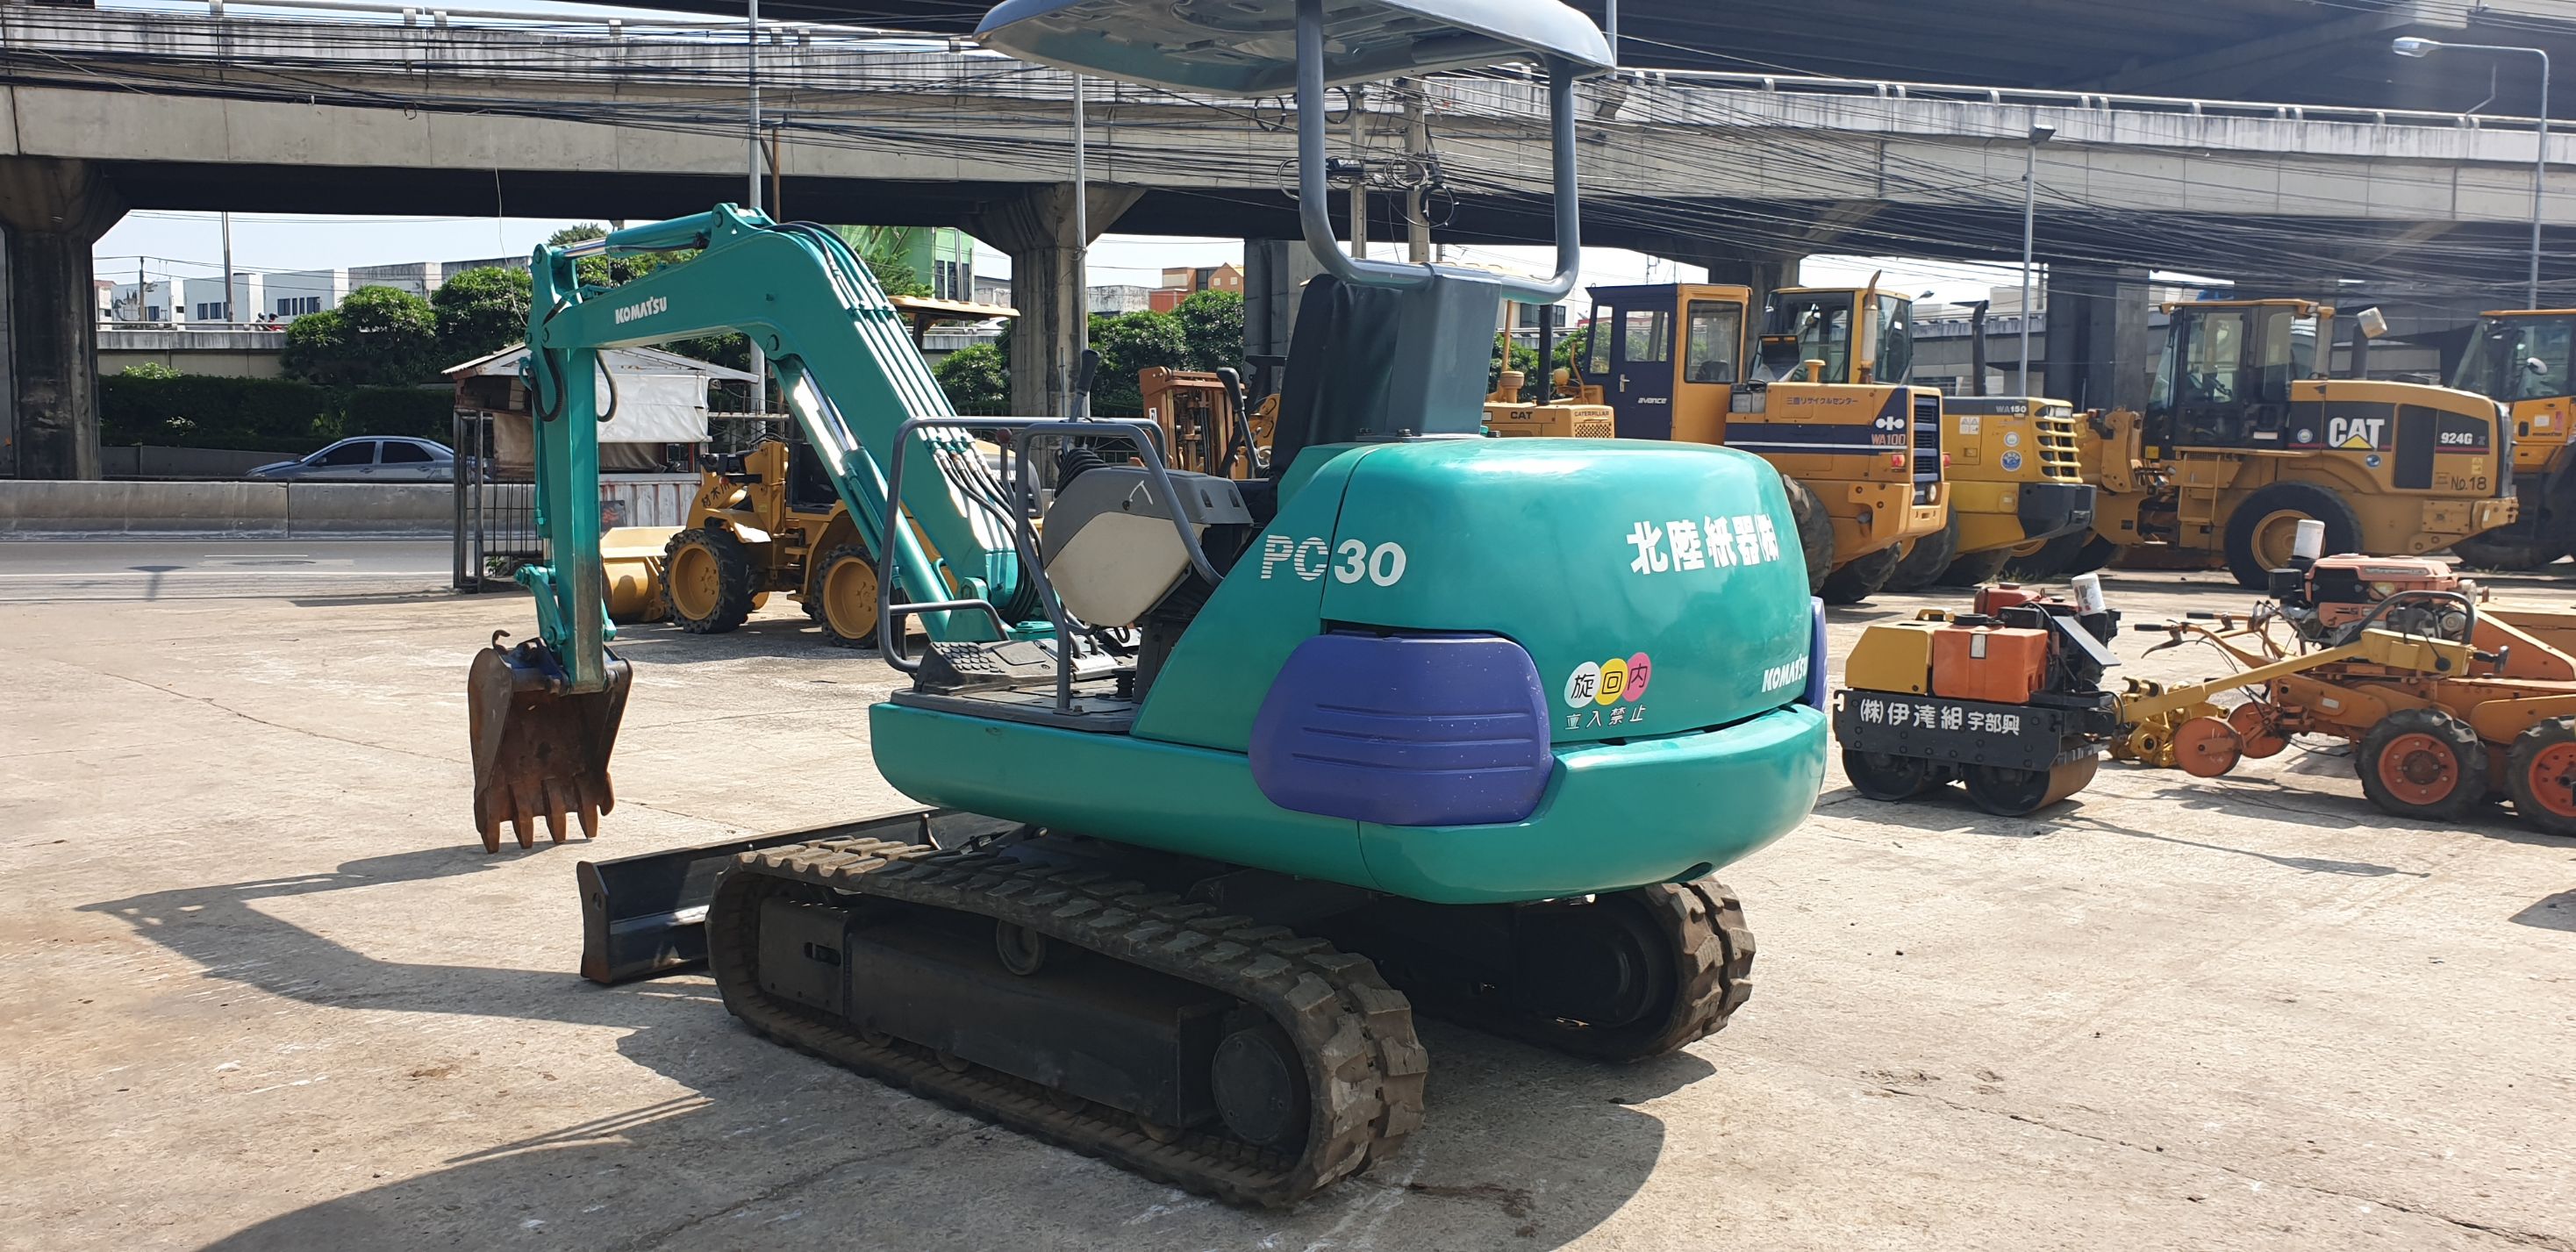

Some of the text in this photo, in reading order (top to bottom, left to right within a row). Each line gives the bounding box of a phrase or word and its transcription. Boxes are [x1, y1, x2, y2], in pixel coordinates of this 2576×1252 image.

[615, 297, 668, 325] KOMATSU
[1510, 411, 1534, 419] CAT
[1871, 433, 1906, 446] WA100
[2329, 417, 2385, 450] CAT
[2440, 432, 2473, 445] 924G
[1260, 534, 1407, 587] PC30
[1571, 662, 1649, 700] 旋回内
[1761, 653, 1808, 693] KOMATSU
